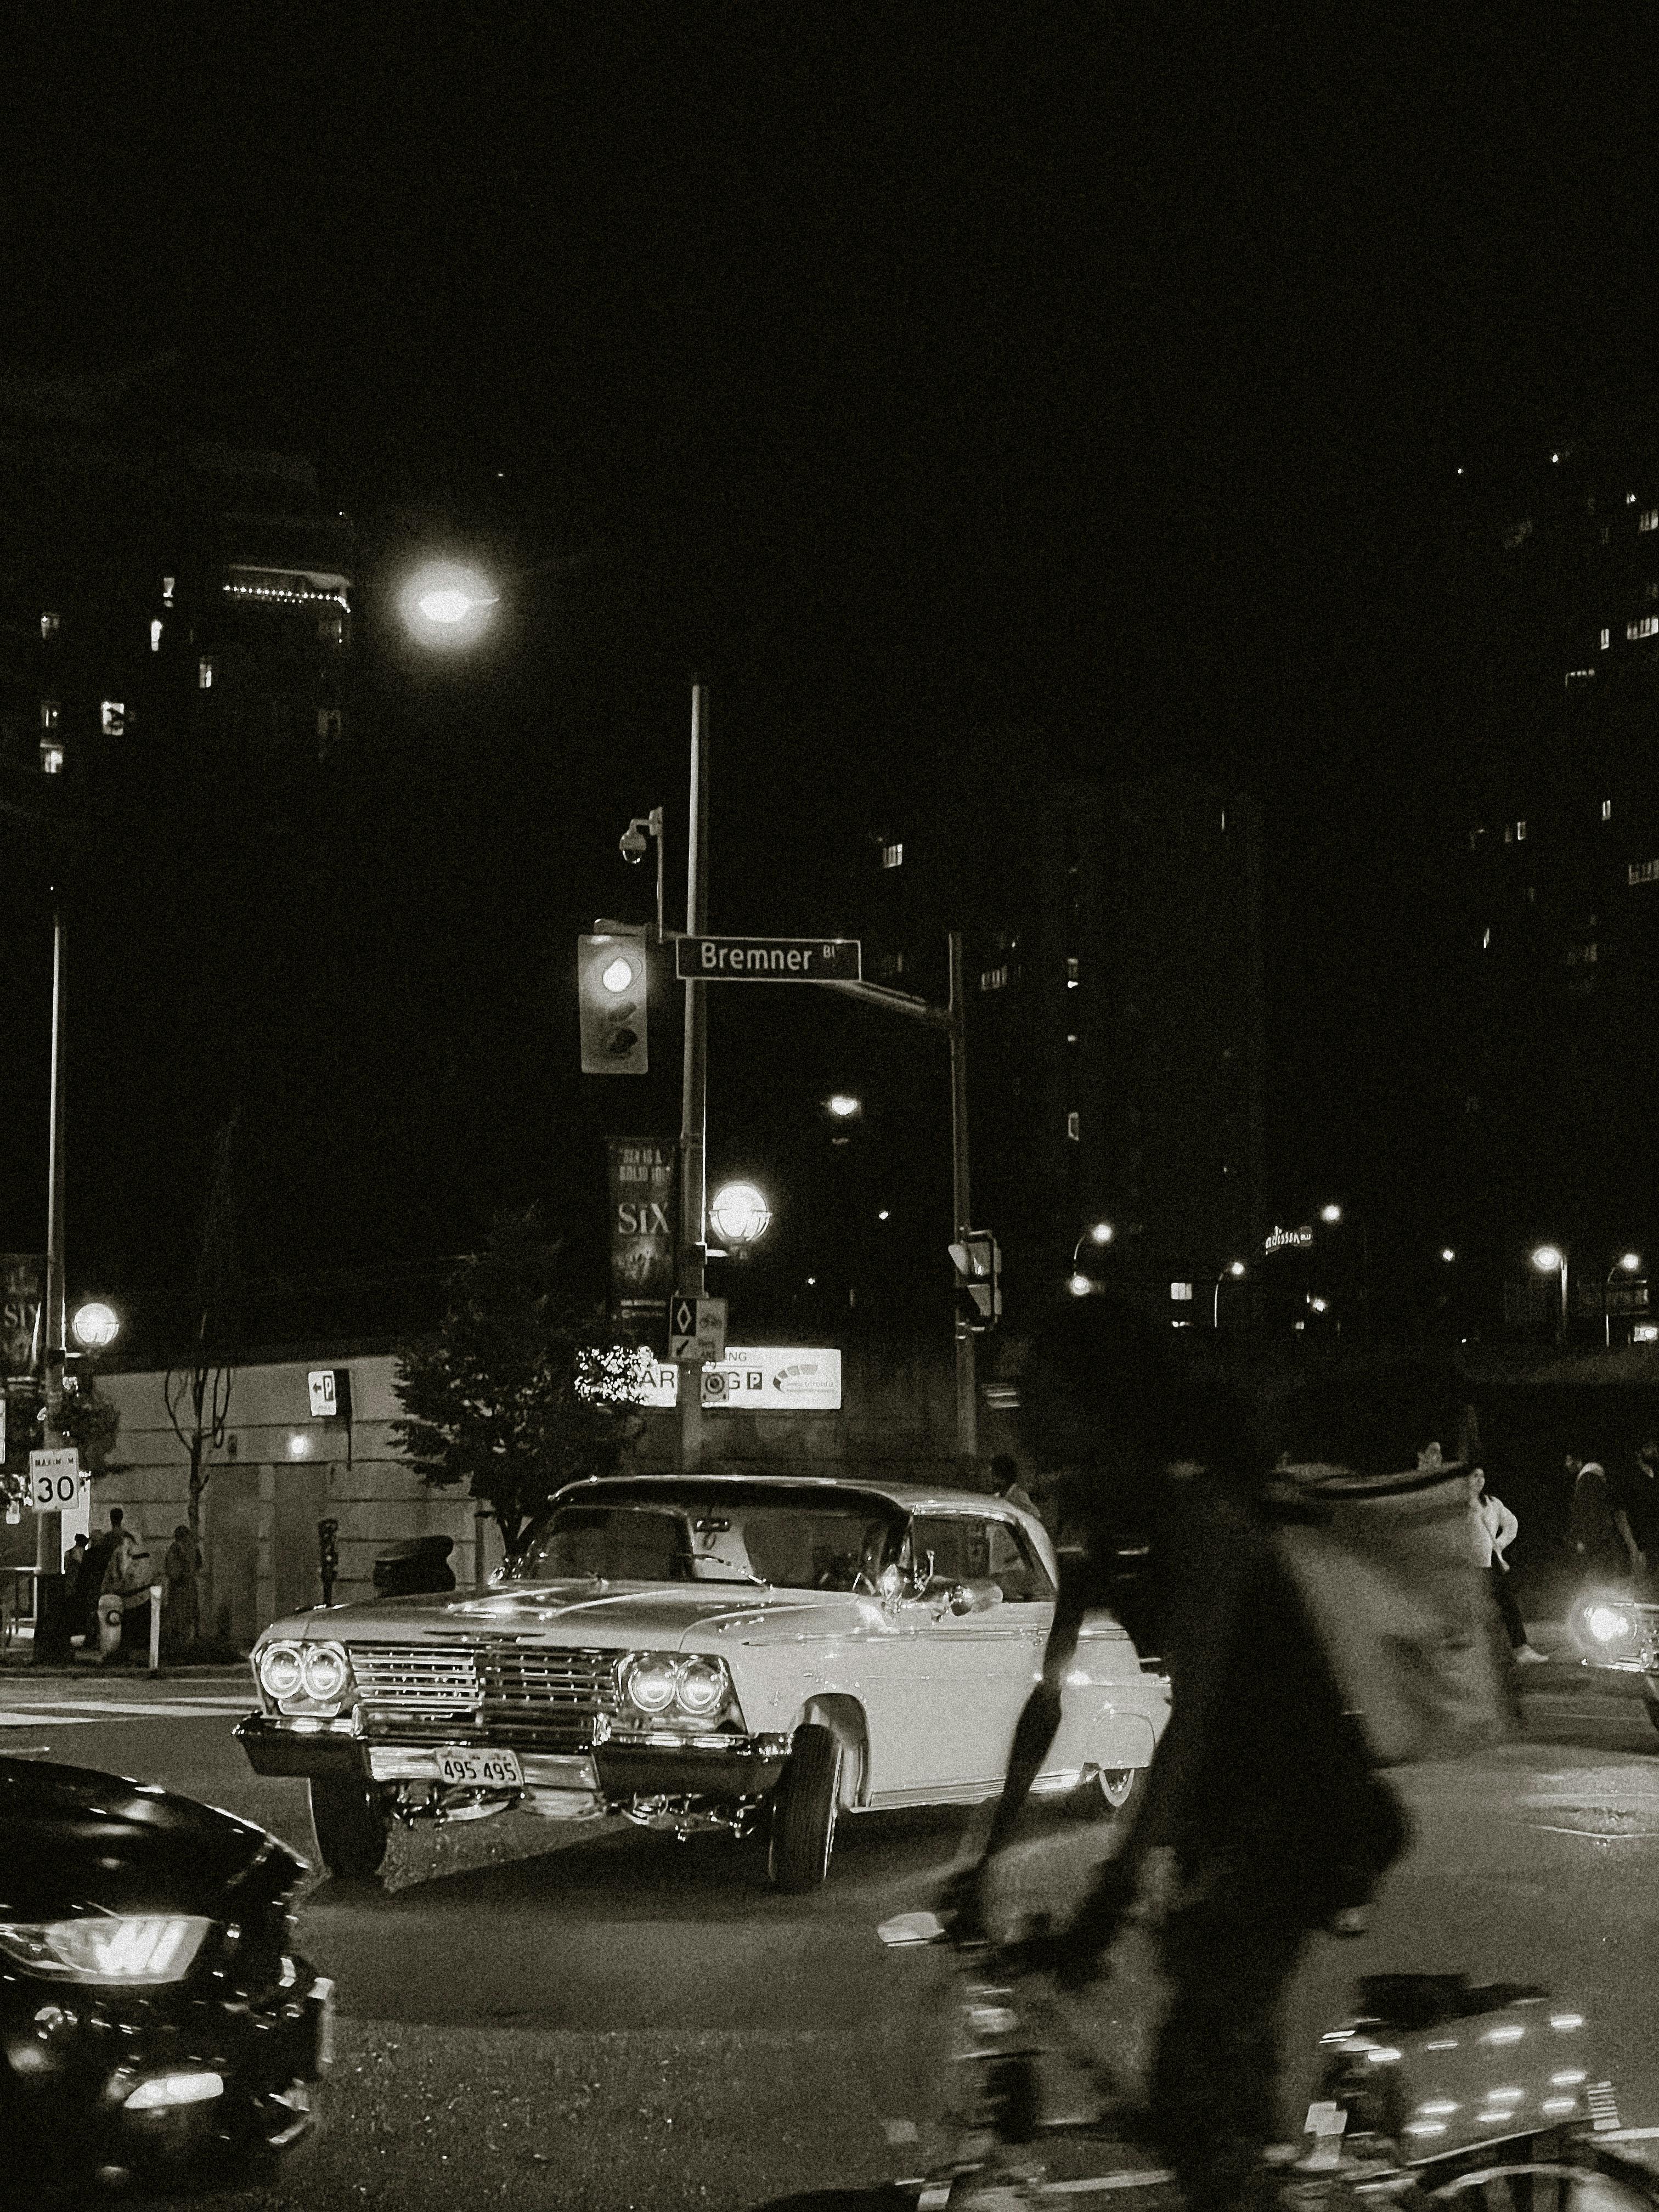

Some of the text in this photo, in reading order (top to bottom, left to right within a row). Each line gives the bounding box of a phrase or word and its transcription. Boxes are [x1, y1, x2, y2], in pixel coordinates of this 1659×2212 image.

[701, 941, 812, 970] Bremner
[618, 1203, 670, 1233] SIX
[1265, 1226, 1300, 1249] adisson
[324, 1377, 332, 1400] P
[35, 1457, 74, 1466] MAXMM
[37, 1476, 74, 1503] 30
[444, 1760, 516, 1781] 495 495
